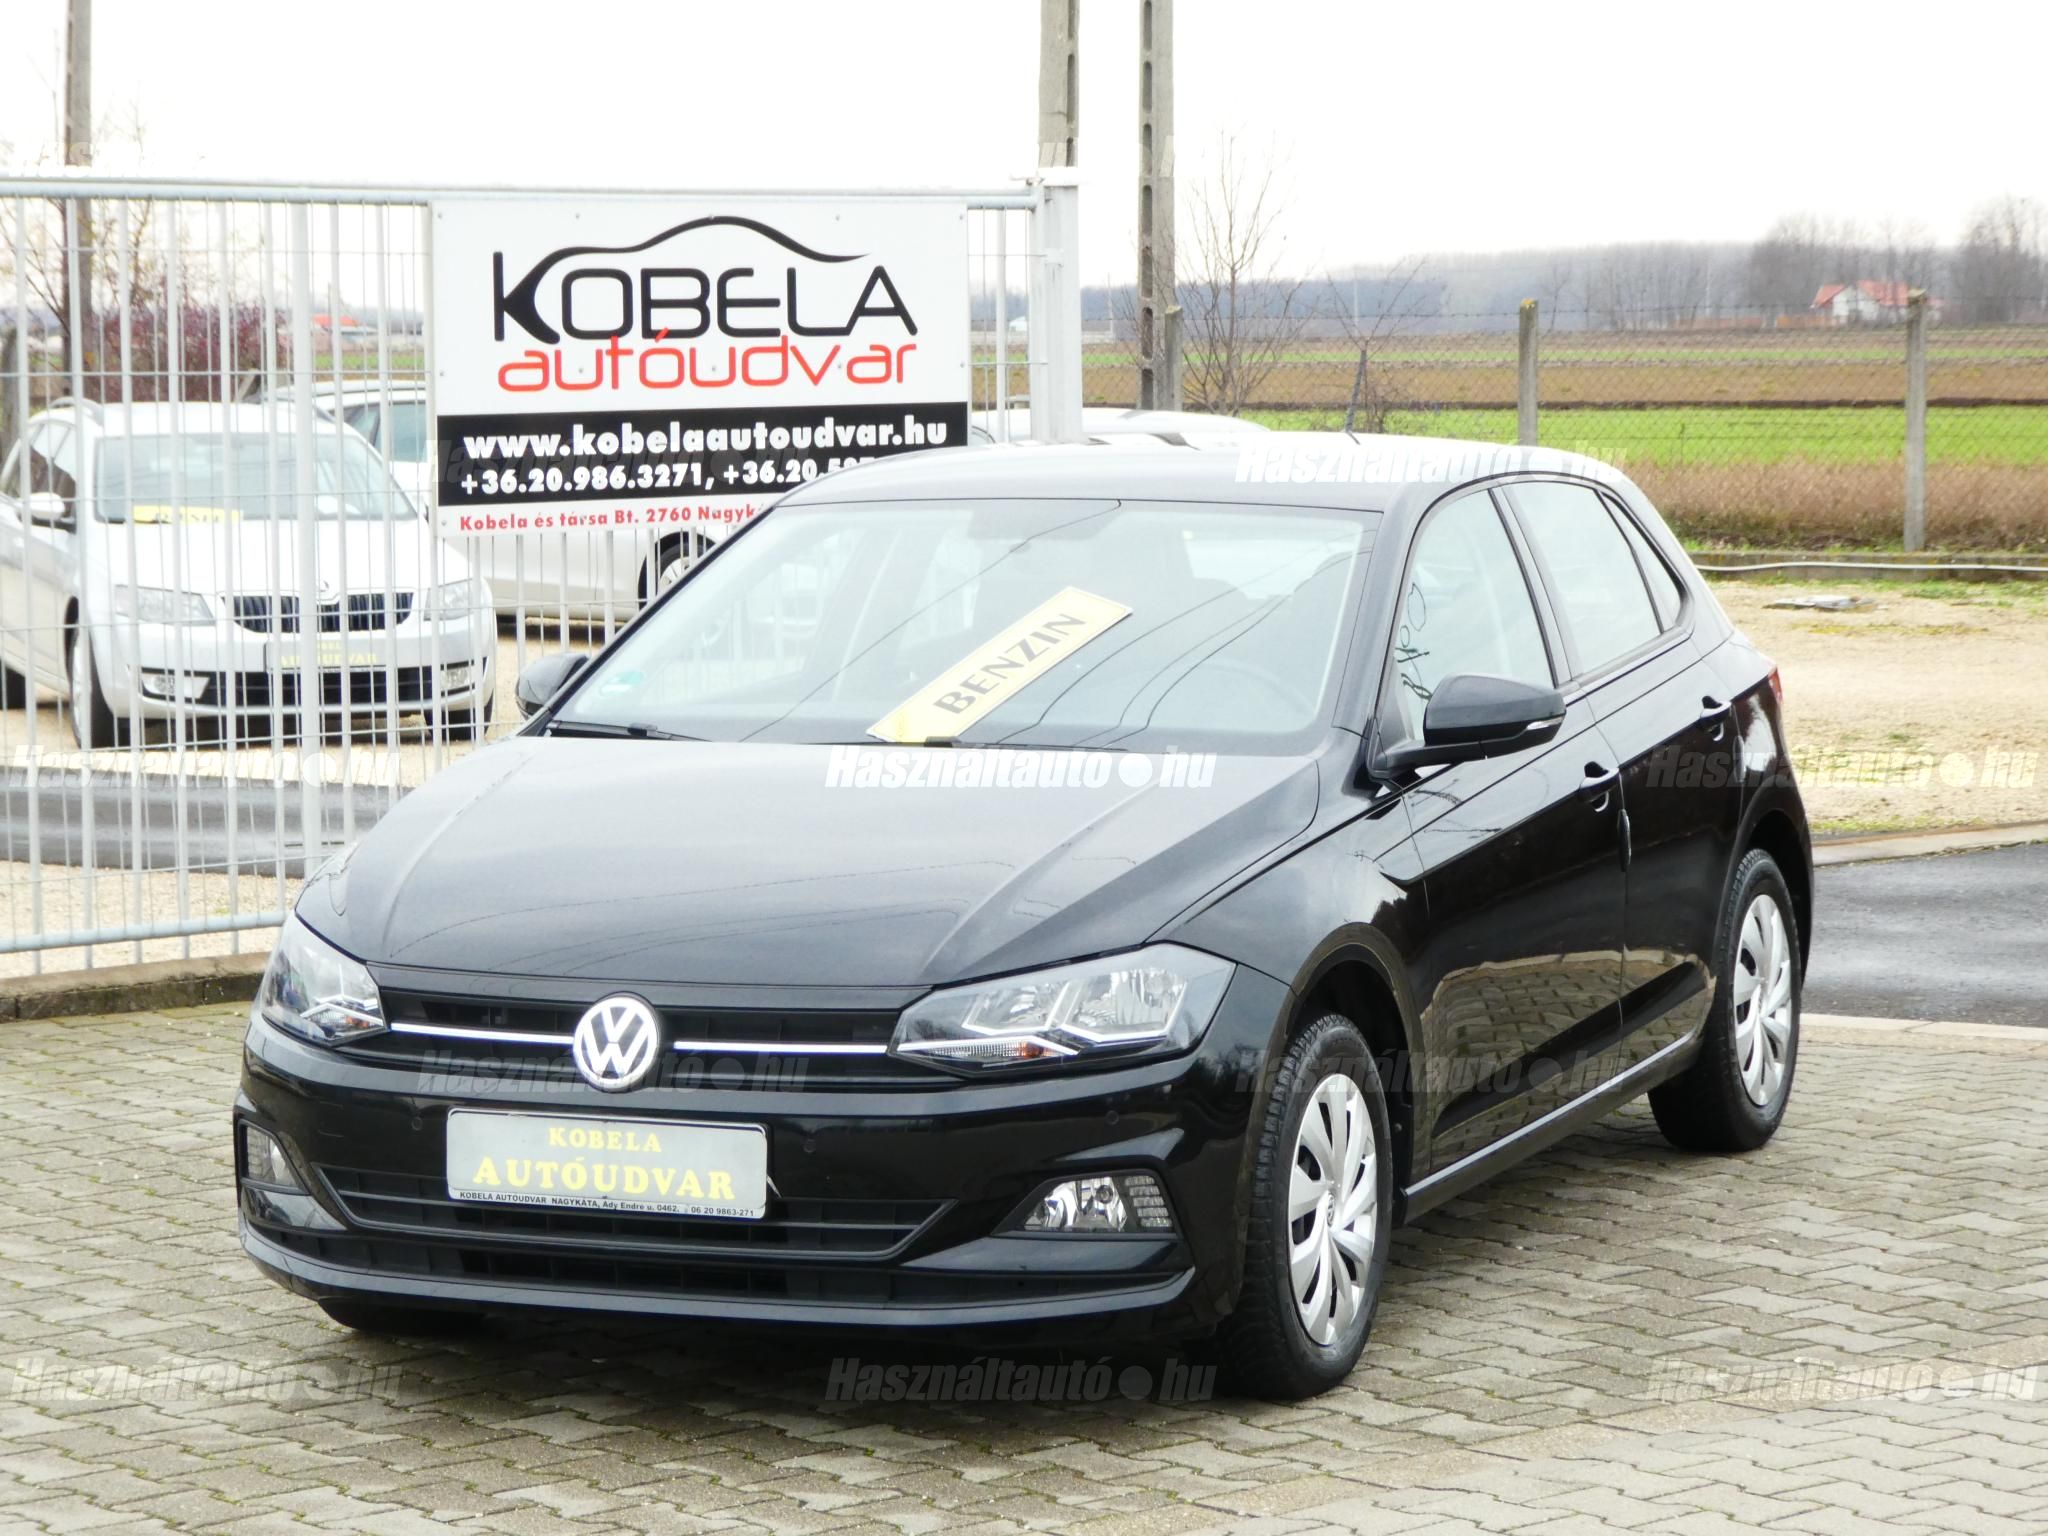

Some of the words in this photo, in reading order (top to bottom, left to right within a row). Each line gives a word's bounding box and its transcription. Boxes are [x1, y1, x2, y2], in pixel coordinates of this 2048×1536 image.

[493, 251, 918, 344] KOBELA
[497, 327, 917, 392] autóudvar
[463, 414, 948, 460] www.kobelaautoudvar.hu
[460, 513, 528, 530] Kobela
[534, 512, 554, 528] és
[560, 511, 607, 525] társa
[614, 509, 639, 524] Bt.
[646, 507, 691, 523] 2760
[932, 612, 1087, 714] BENZIN
[548, 1126, 662, 1153] KOBELA
[472, 1156, 735, 1200] AUTÓUDVAR
[459, 1191, 494, 1201] KOBELA
[620, 1203, 645, 1211] Endre
[691, 1206, 702, 1214] 06
[703, 1207, 714, 1215] 20
